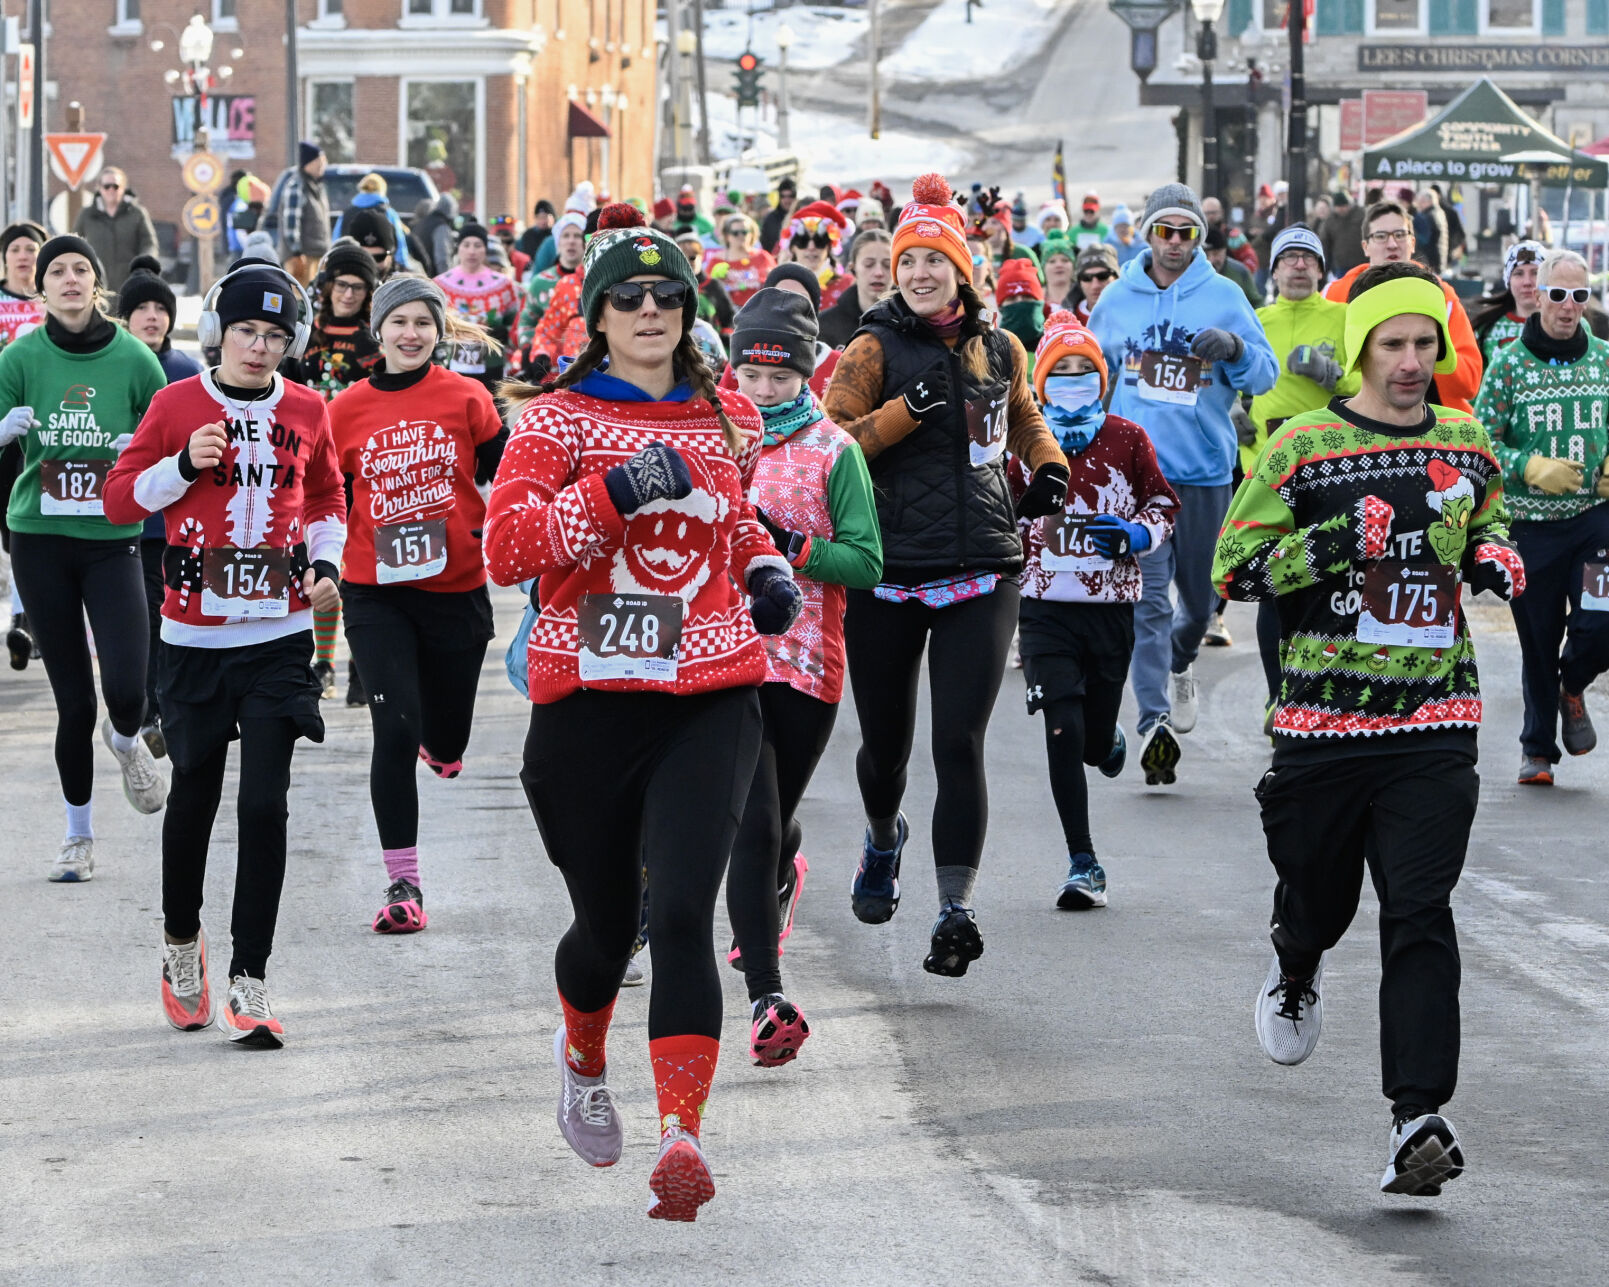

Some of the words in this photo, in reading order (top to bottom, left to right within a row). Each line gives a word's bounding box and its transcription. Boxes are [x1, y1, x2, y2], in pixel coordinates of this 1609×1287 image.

[1419, 48, 1534, 65] CHRISTMAS
[1537, 48, 1609, 65] CORNE
[1441, 122, 1531, 137] COMMUNITY
[1441, 141, 1501, 151] CENTER
[1377, 157, 1392, 175] A
[1395, 158, 1444, 178] place
[1447, 159, 1466, 176] to
[1468, 162, 1515, 180] grow
[1154, 363, 1187, 389] 156
[48, 413, 101, 432] SANTA,
[1527, 403, 1563, 432] FA
[1574, 400, 1603, 430] LA
[38, 430, 59, 446] WE
[62, 430, 111, 447] GOOD?
[223, 418, 260, 442] ME
[272, 424, 302, 457] ON
[383, 433, 388, 448] I
[392, 425, 427, 446] HAVE
[1551, 434, 1585, 463] LA
[360, 440, 458, 478] Everything
[57, 472, 97, 498] 182
[213, 461, 295, 489] SANTA
[385, 470, 417, 491] WANT
[420, 465, 442, 483] FOR
[371, 479, 453, 519] Christmas
[391, 533, 431, 565] 151
[1056, 527, 1096, 554] 146
[223, 563, 271, 596] 154
[1345, 564, 1366, 587] to
[1596, 574, 1609, 597] 1
[1387, 583, 1438, 622] 175
[600, 613, 659, 653] 248
